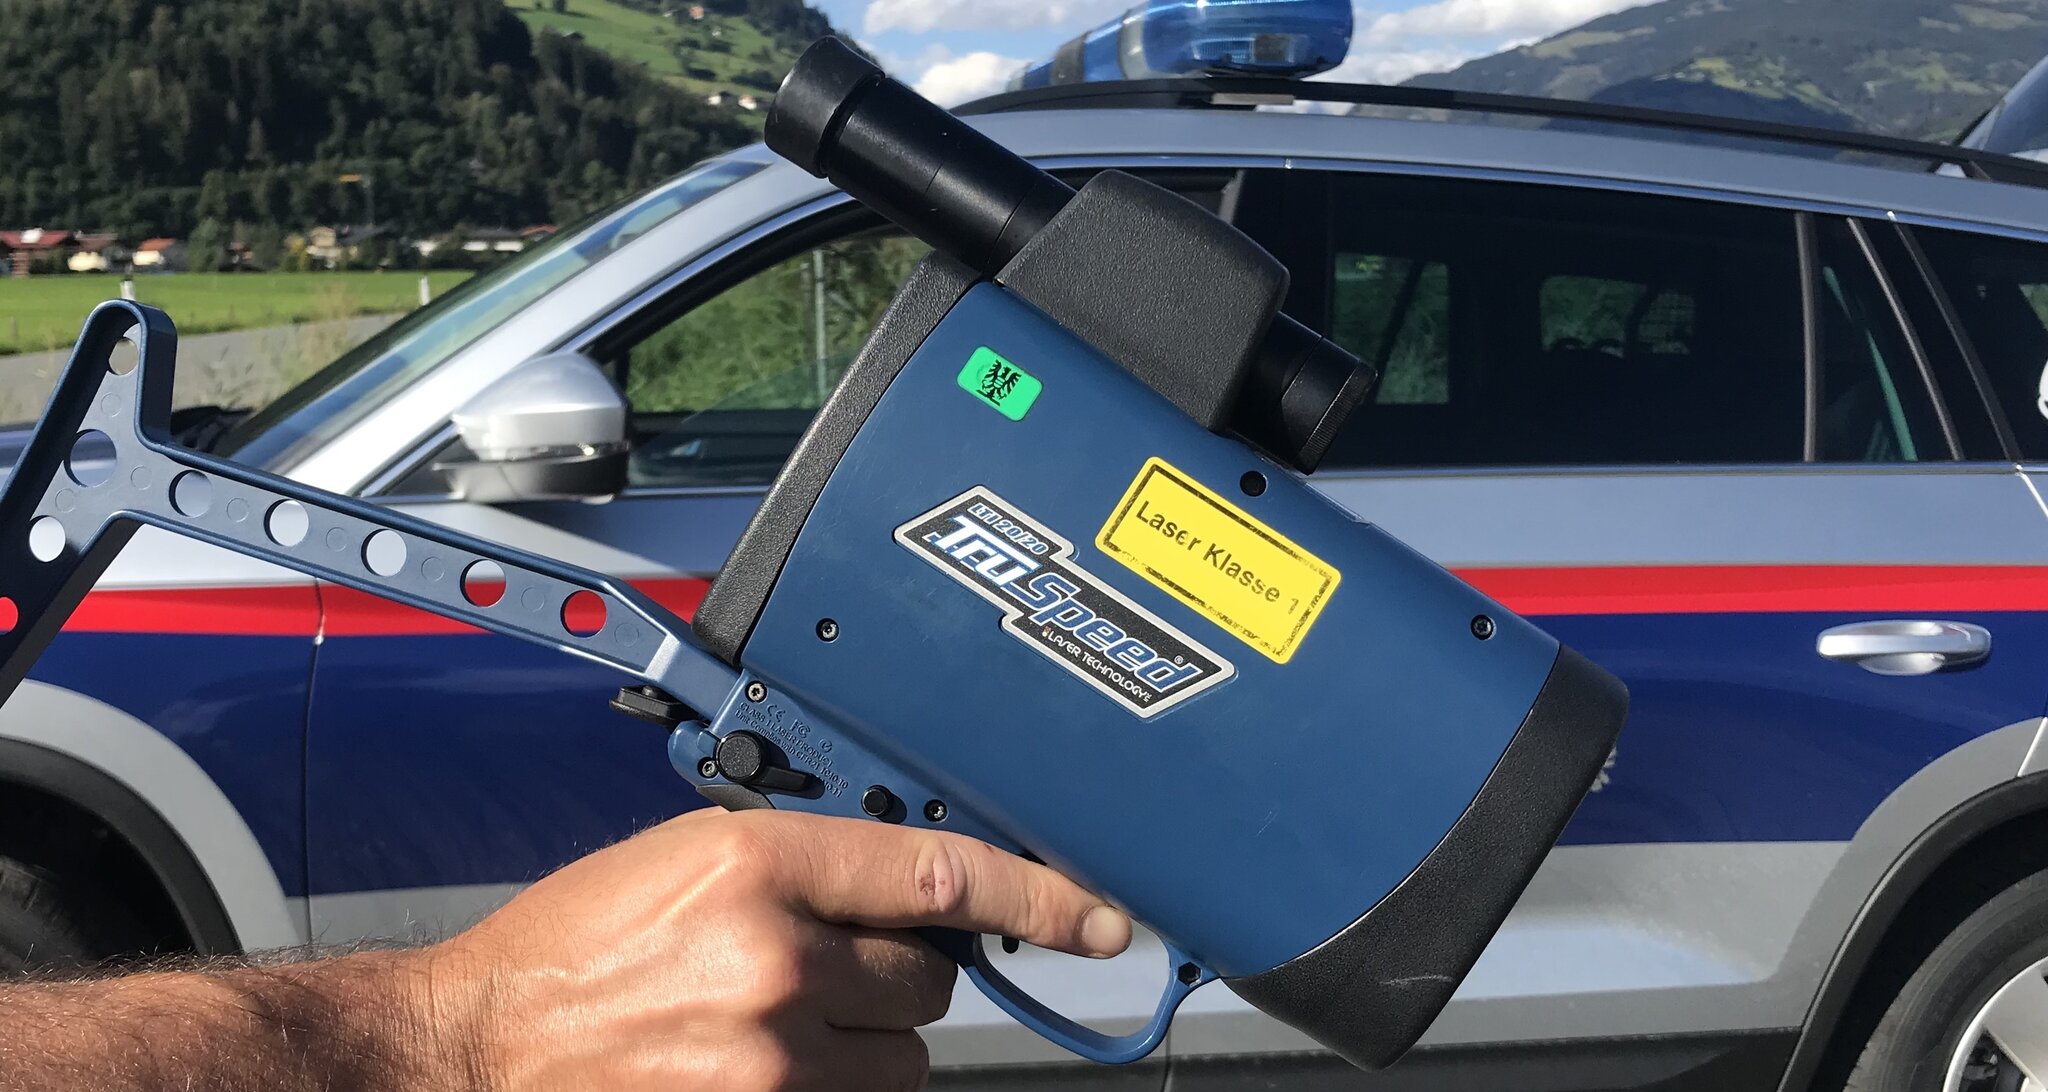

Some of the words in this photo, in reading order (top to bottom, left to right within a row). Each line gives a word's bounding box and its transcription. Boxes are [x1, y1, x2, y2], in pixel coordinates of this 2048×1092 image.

[968, 503, 1002, 525] LTI
[993, 517, 1049, 555] 20/20
[1136, 501, 1201, 551] Laser
[1203, 543, 1281, 603] Klasse
[1286, 597, 1300, 615] 1
[1048, 631, 1081, 658] LASER
[1082, 651, 1147, 697] TECHNOLOGY
[740, 702, 766, 722] CLASS
[771, 721, 797, 744] LASER
[795, 739, 834, 768] PRODUCT
